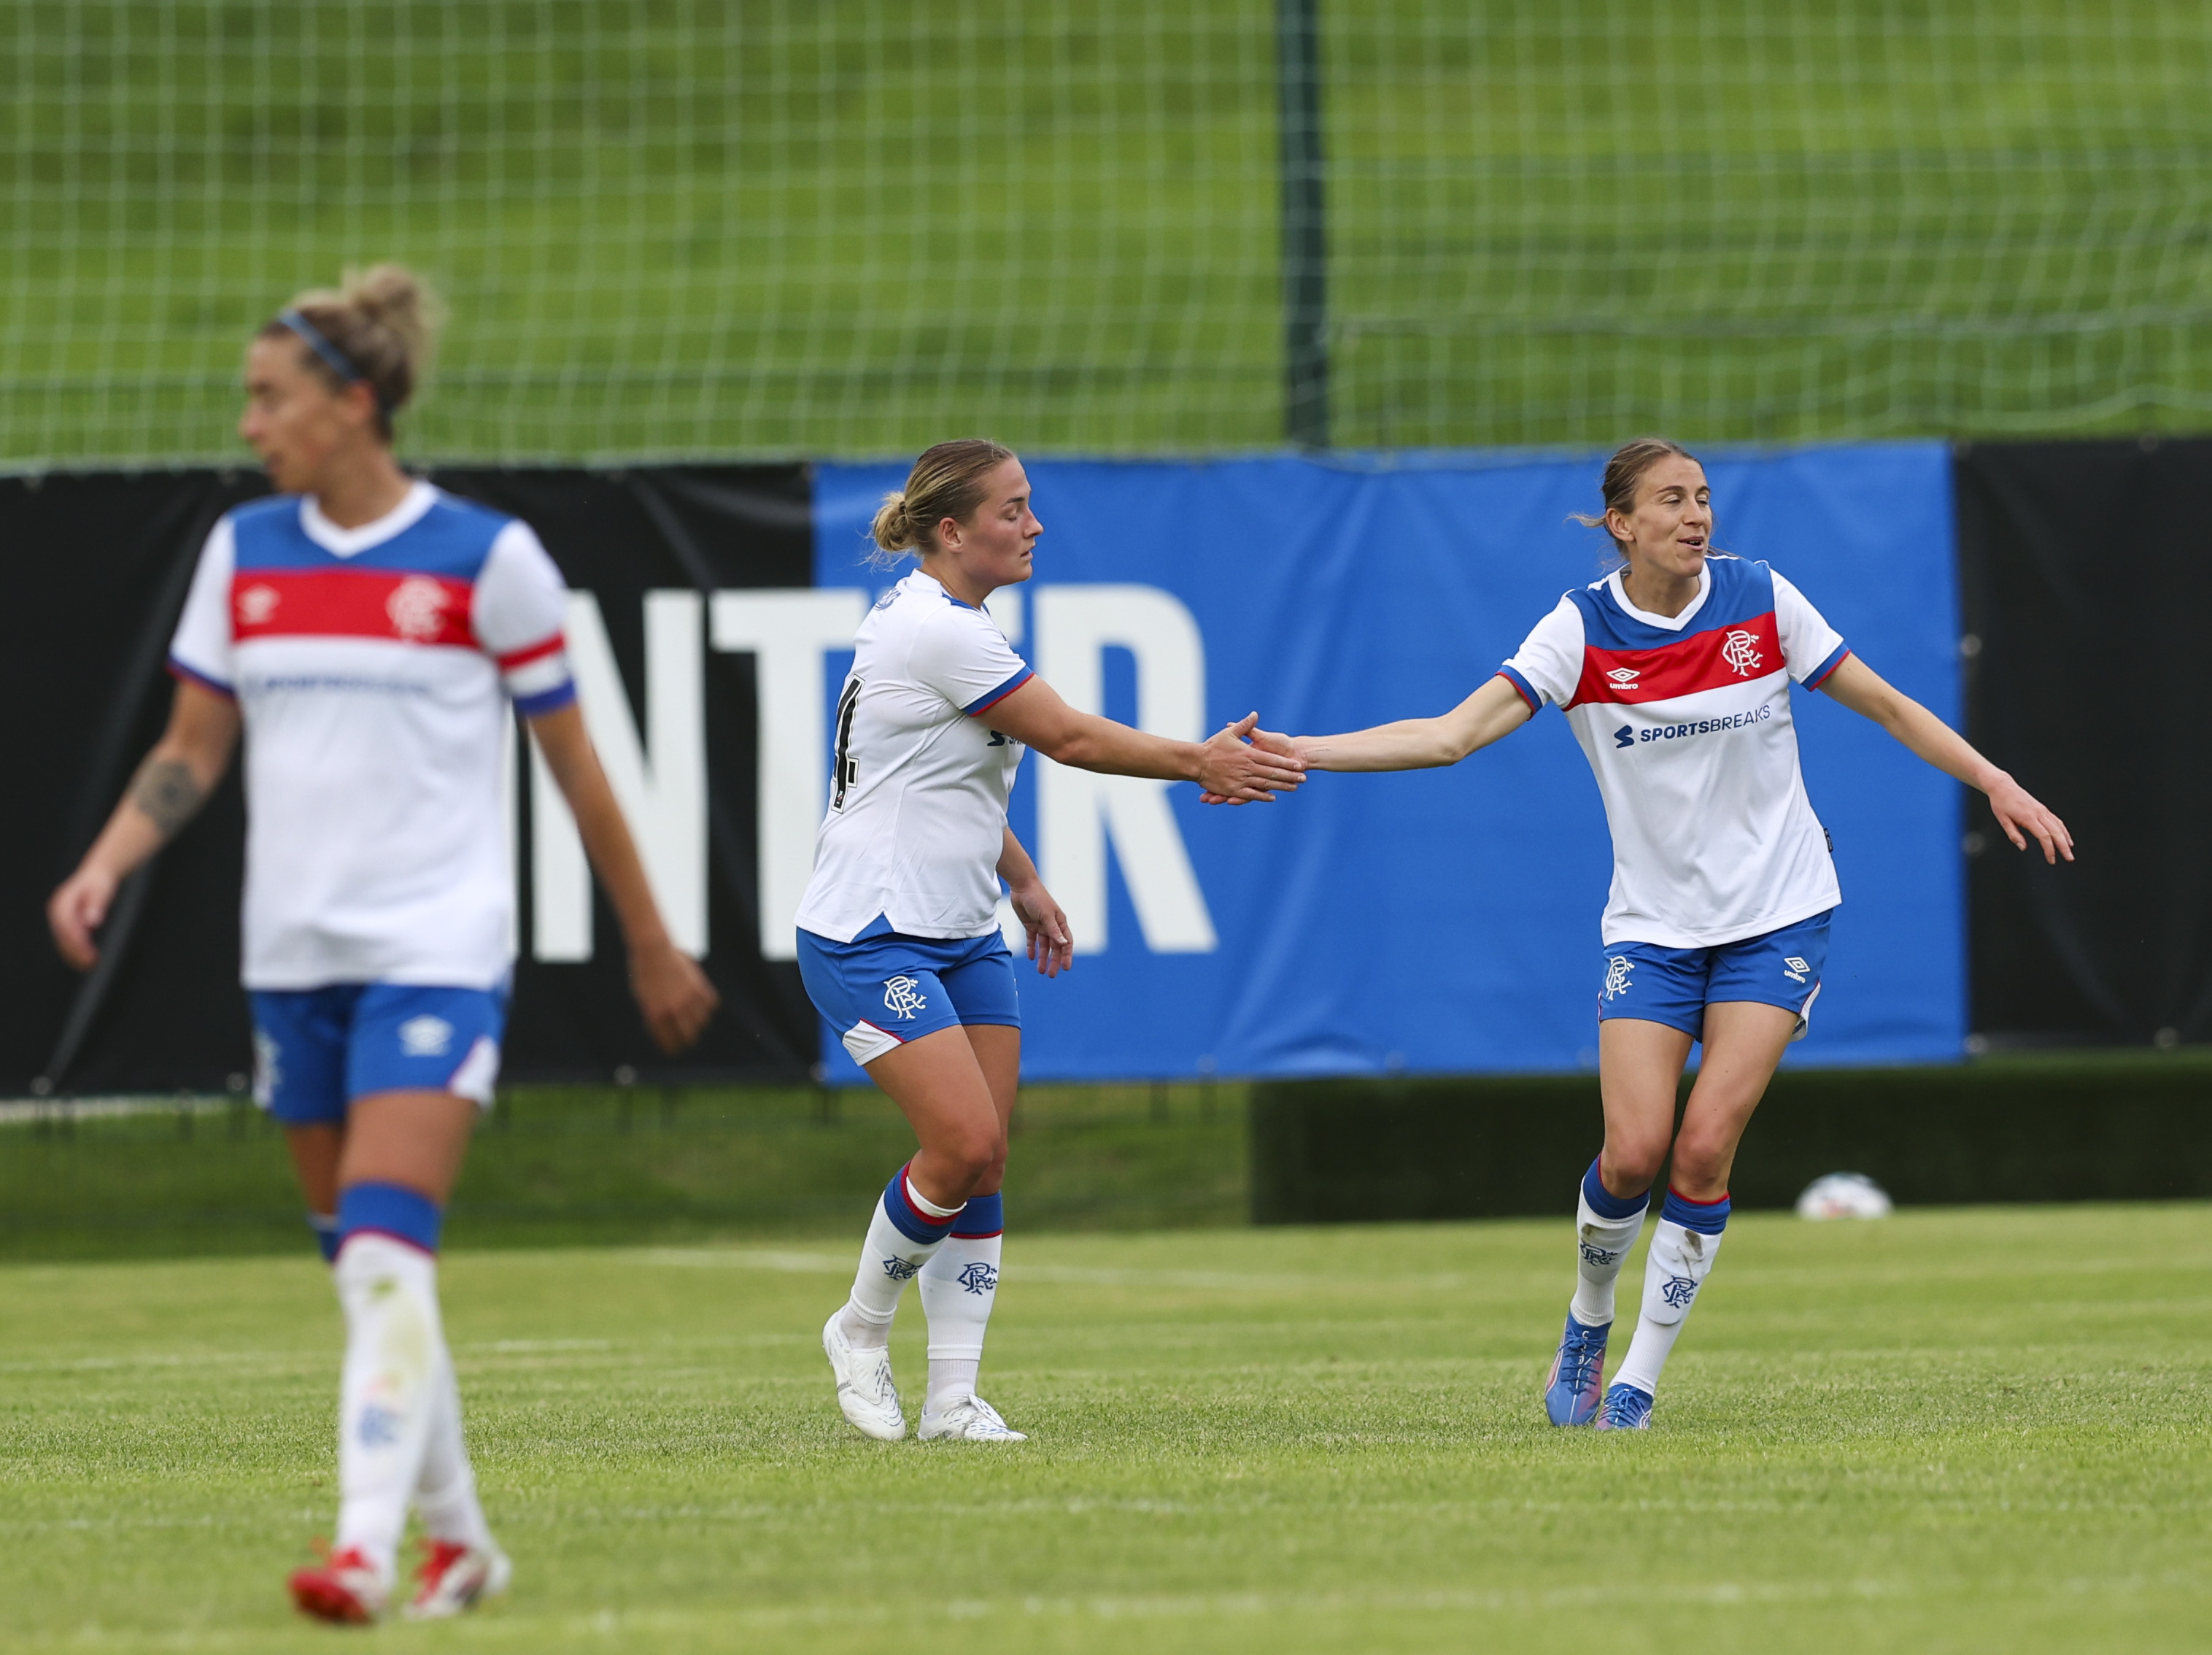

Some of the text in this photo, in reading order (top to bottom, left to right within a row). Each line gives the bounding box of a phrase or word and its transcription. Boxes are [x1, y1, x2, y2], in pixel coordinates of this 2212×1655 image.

[1640, 704, 1771, 742] SPORTSBREAKS
[830, 673, 866, 814] 4
[1784, 969, 1806, 984] umbro
